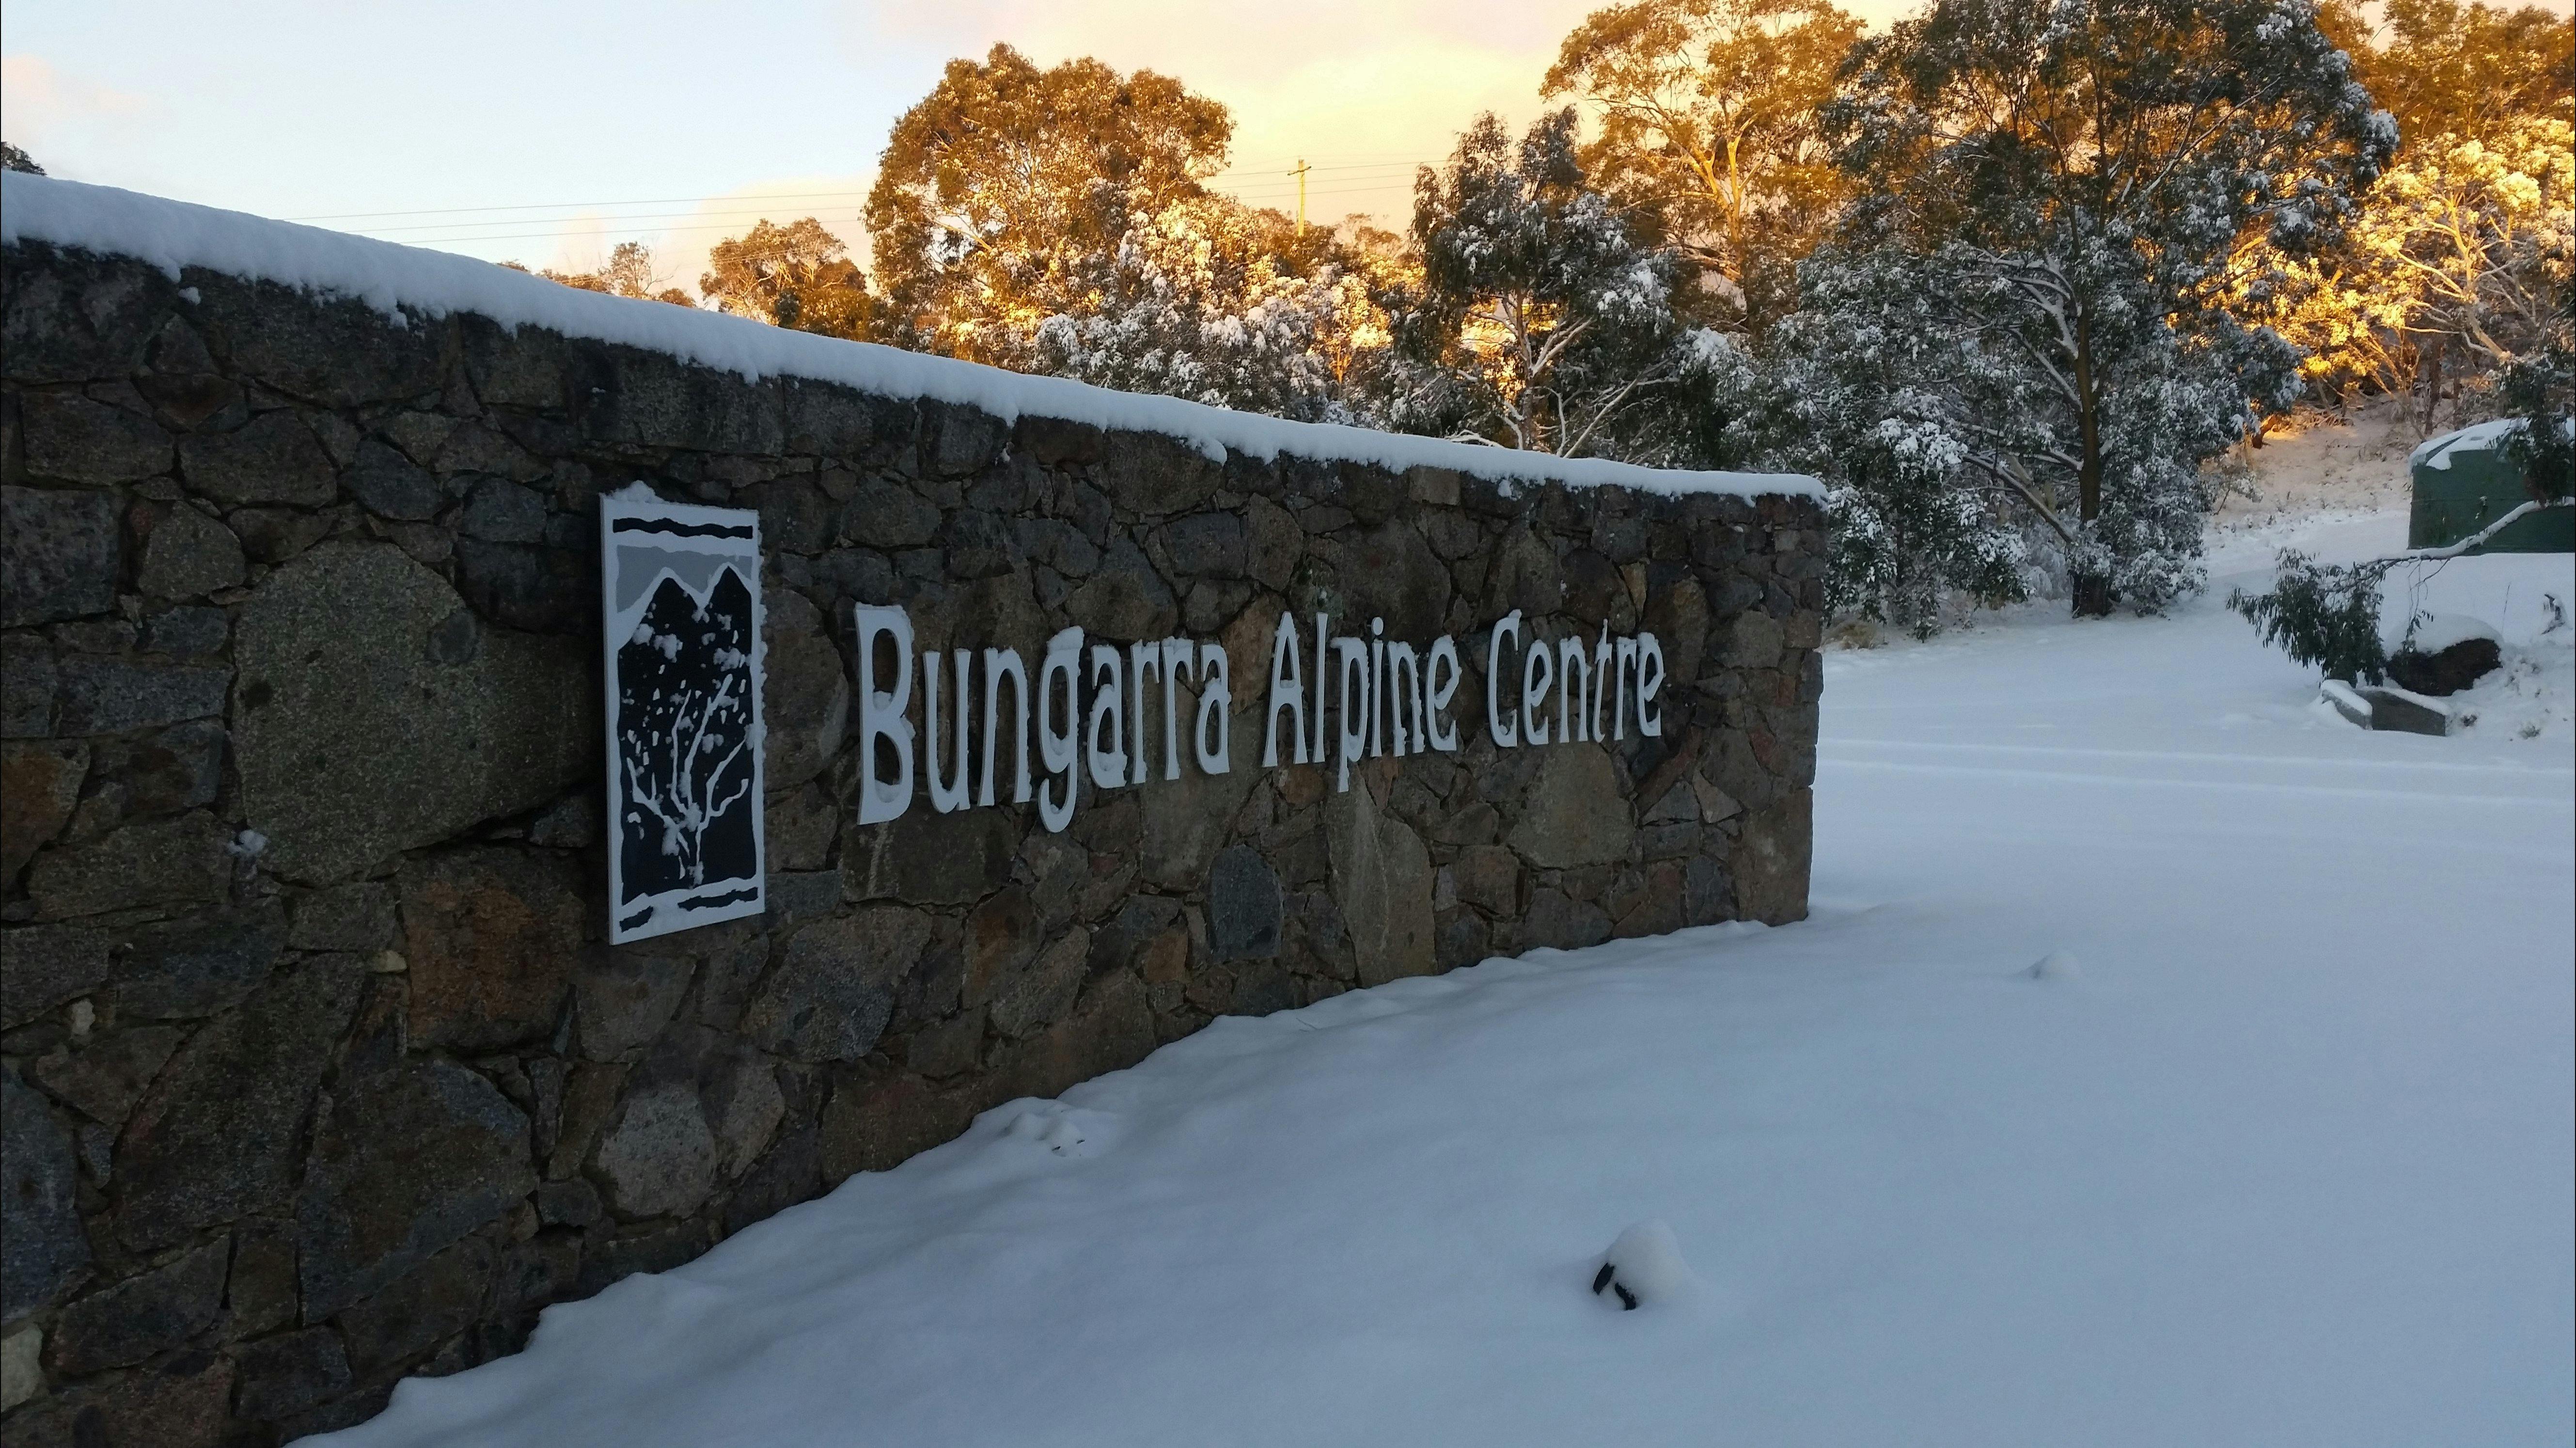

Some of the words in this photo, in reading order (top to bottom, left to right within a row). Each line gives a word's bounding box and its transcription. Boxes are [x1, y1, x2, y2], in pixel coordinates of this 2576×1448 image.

[855, 602, 1231, 833] Bungarra
[1262, 612, 1461, 792] Alpine
[1488, 609, 1662, 747] Centre
